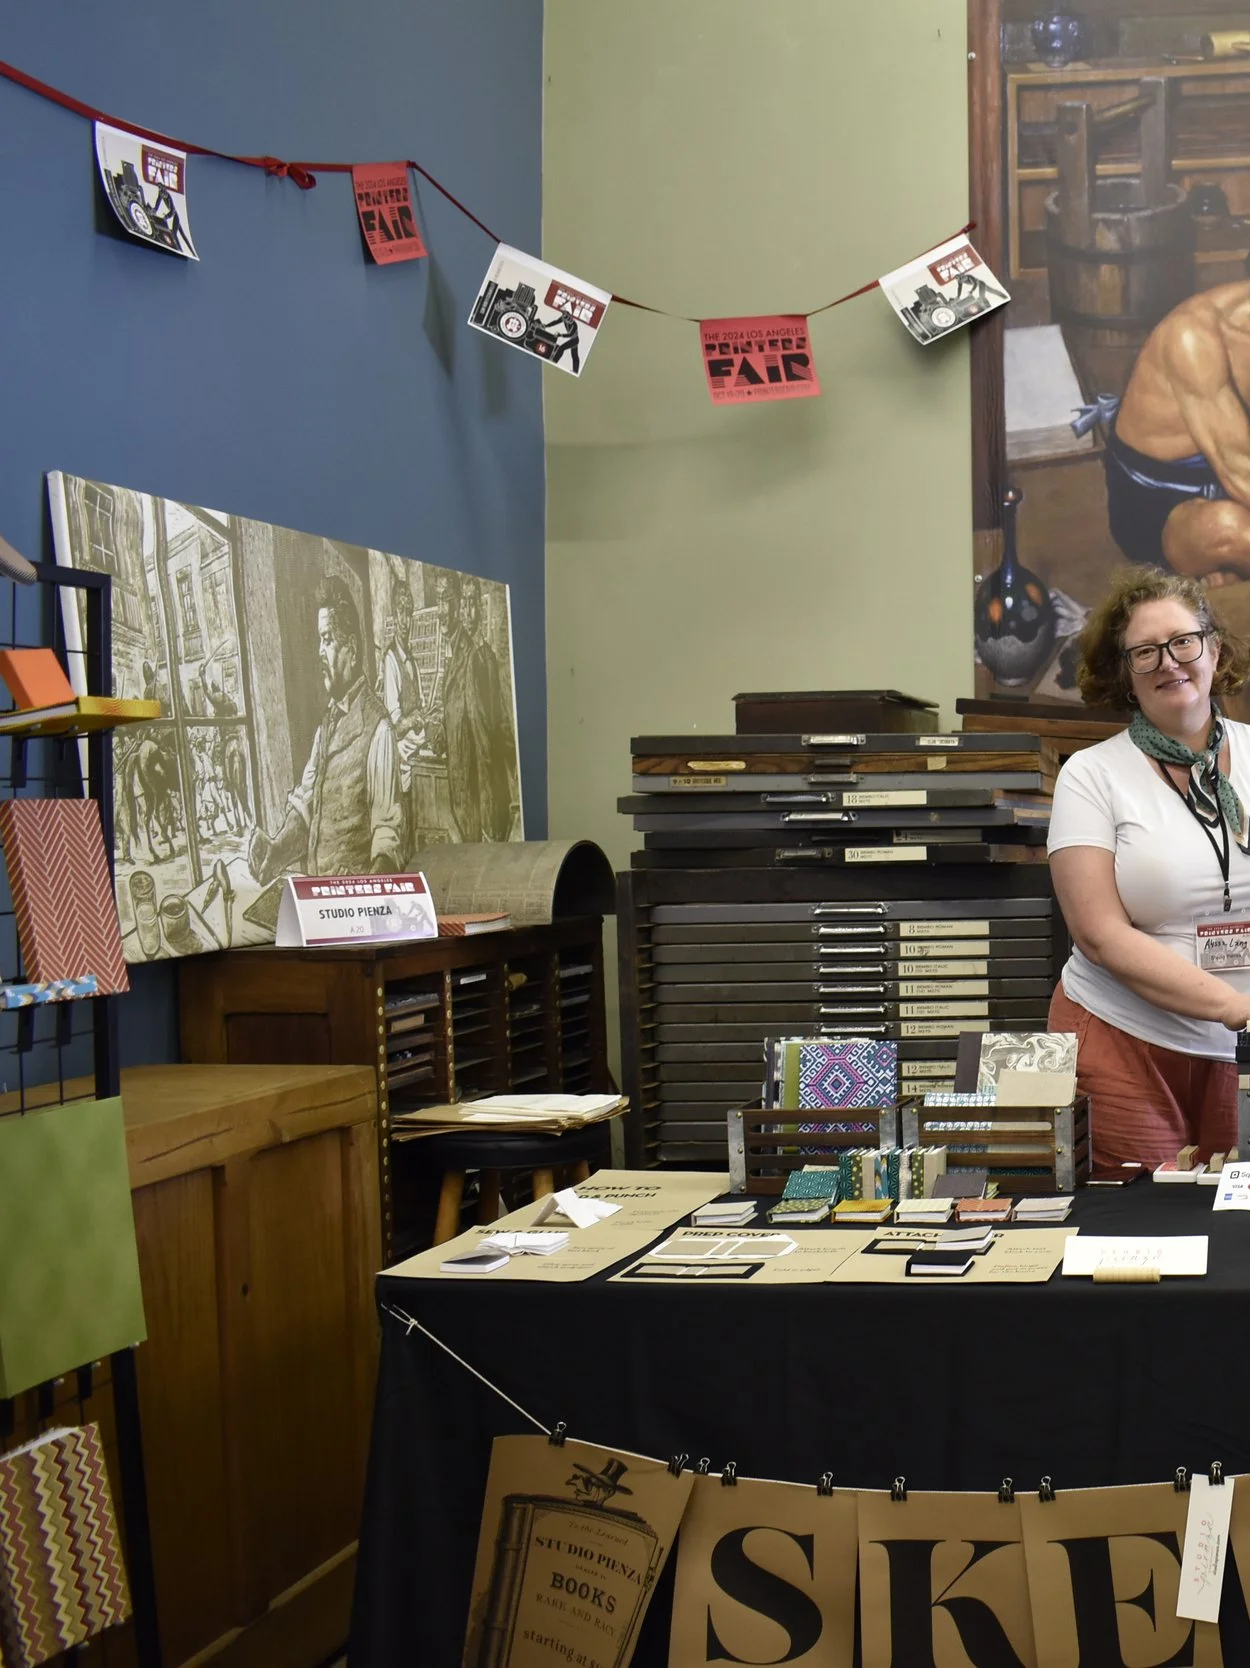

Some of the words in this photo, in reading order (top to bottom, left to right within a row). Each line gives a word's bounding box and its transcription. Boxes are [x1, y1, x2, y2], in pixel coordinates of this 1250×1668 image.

[147, 167, 179, 190] FAIR
[357, 187, 409, 207] PRINTERS
[361, 205, 418, 245] FAIR
[939, 256, 973, 282] FAIR
[553, 296, 593, 323] FAIR
[704, 332, 720, 341] THE
[722, 331, 744, 341] 2024
[747, 330, 763, 339] LOS
[766, 327, 805, 338] ANGELES
[704, 337, 807, 357] PRINTERS
[707, 353, 814, 389] FAIR
[311, 883, 382, 896] PRINTERS
[384, 882, 415, 894] FAIR
[319, 907, 355, 919] STUDIO
[357, 905, 393, 917] PIENZA
[1205, 938, 1227, 949] Alyssa
[1229, 938, 1248, 949] Lang
[535, 1536, 594, 1562] STUDIO
[597, 1554, 642, 1586] PIENZA
[550, 1571, 617, 1614] BOOKS
[536, 1593, 567, 1613] RARE
[570, 1606, 592, 1623] AND
[523, 1628, 575, 1663] starting
[576, 1653, 588, 1666] at
